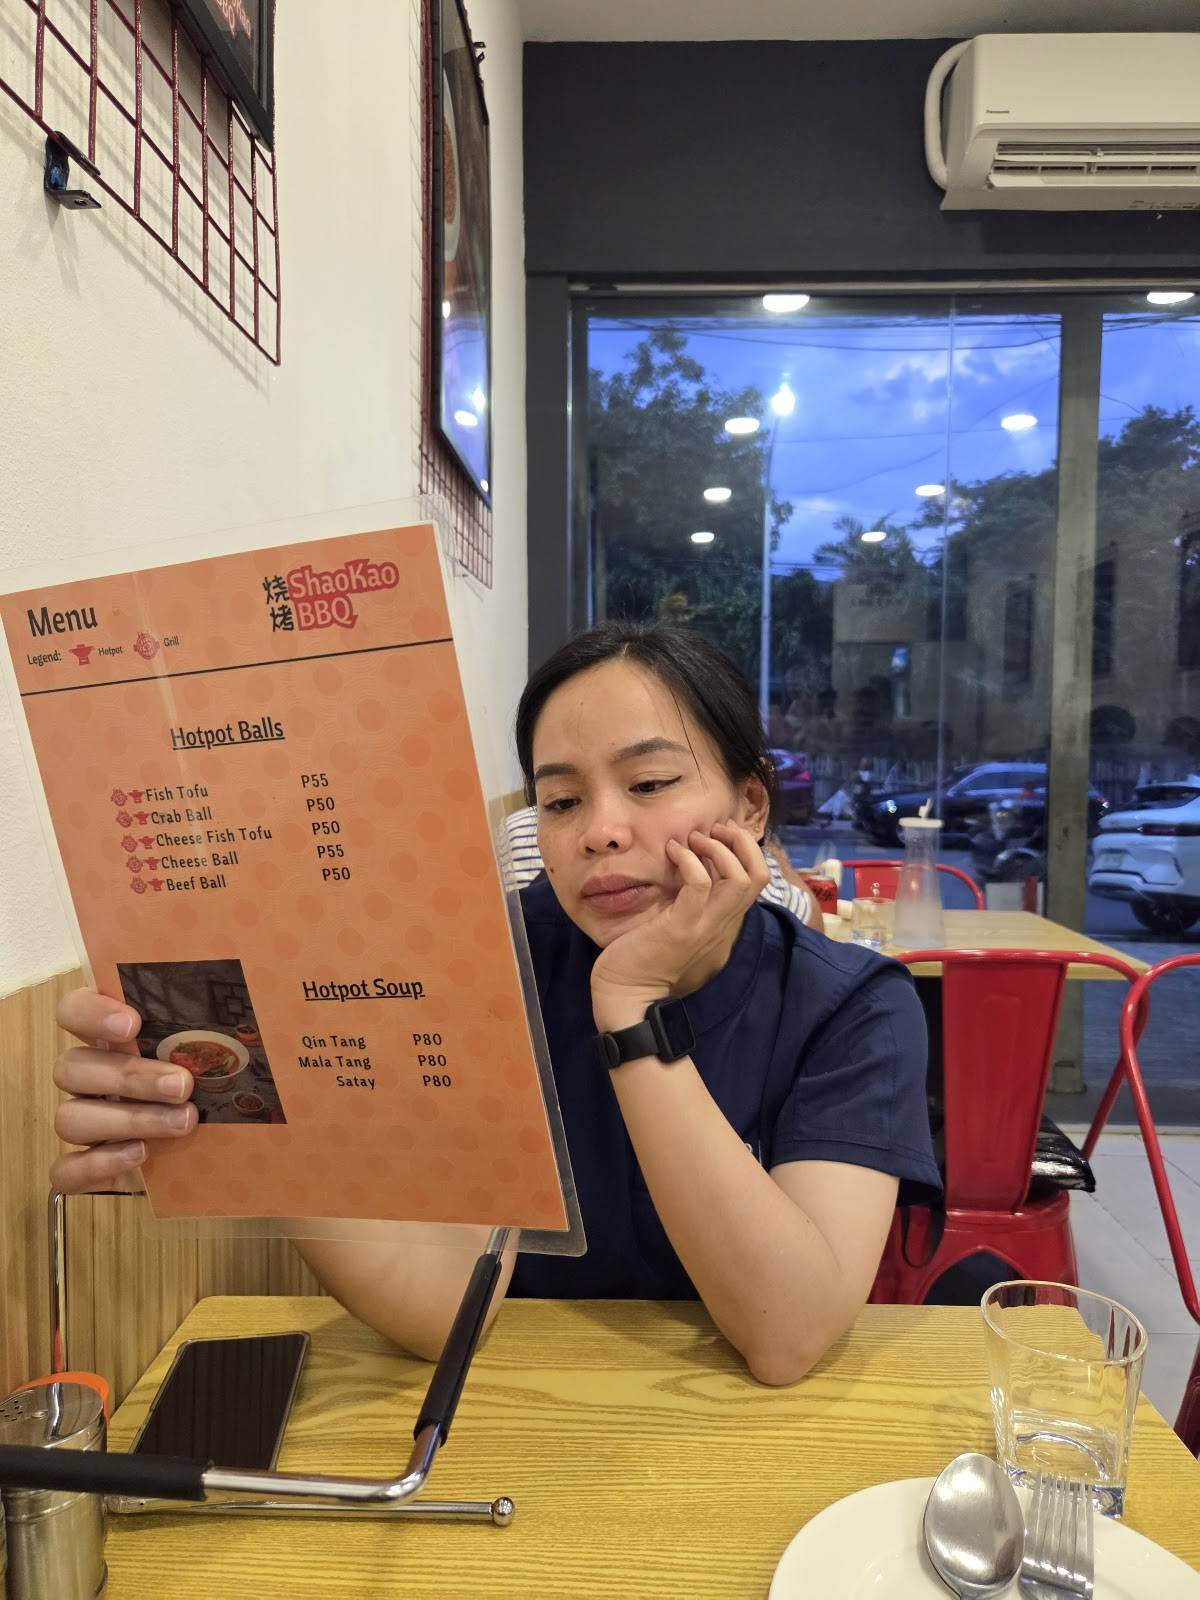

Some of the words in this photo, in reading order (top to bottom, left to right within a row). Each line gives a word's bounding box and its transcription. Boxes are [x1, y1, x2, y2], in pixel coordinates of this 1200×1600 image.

[290, 561, 398, 597] ShaoKao
[27, 603, 99, 637] Menu
[298, 598, 353, 629] BBQ
[27, 650, 62, 666] Legend:
[98, 645, 123, 657] Hotpot
[163, 635, 180, 648] Grill
[170, 724, 235, 750] Hotpot
[239, 717, 286, 743] Balls
[146, 788, 173, 802] Fish
[177, 784, 209, 799] Tofu
[301, 773, 329, 788] P55
[151, 810, 182, 825] Crab
[186, 807, 212, 822] Ball
[306, 796, 335, 812] P50
[156, 833, 202, 848] Cheese
[207, 829, 235, 843] Fish
[239, 826, 272, 841] Tofu
[312, 820, 341, 835] P50
[162, 854, 208, 869] Cheese
[212, 851, 239, 867] Ball
[317, 844, 345, 858] P55
[166, 876, 196, 892] Beef
[201, 874, 226, 889] Ball
[322, 866, 351, 881] P50
[303, 979, 370, 1002] Hotpot
[374, 978, 425, 1000] Soup
[302, 1035, 327, 1050] Qin
[330, 1035, 366, 1050] Tang
[413, 1033, 442, 1046] P80
[298, 1056, 332, 1068] Mala
[336, 1055, 371, 1070] Tang
[418, 1054, 447, 1067] P80
[336, 1076, 375, 1090] Satay
[423, 1075, 452, 1087] P80
